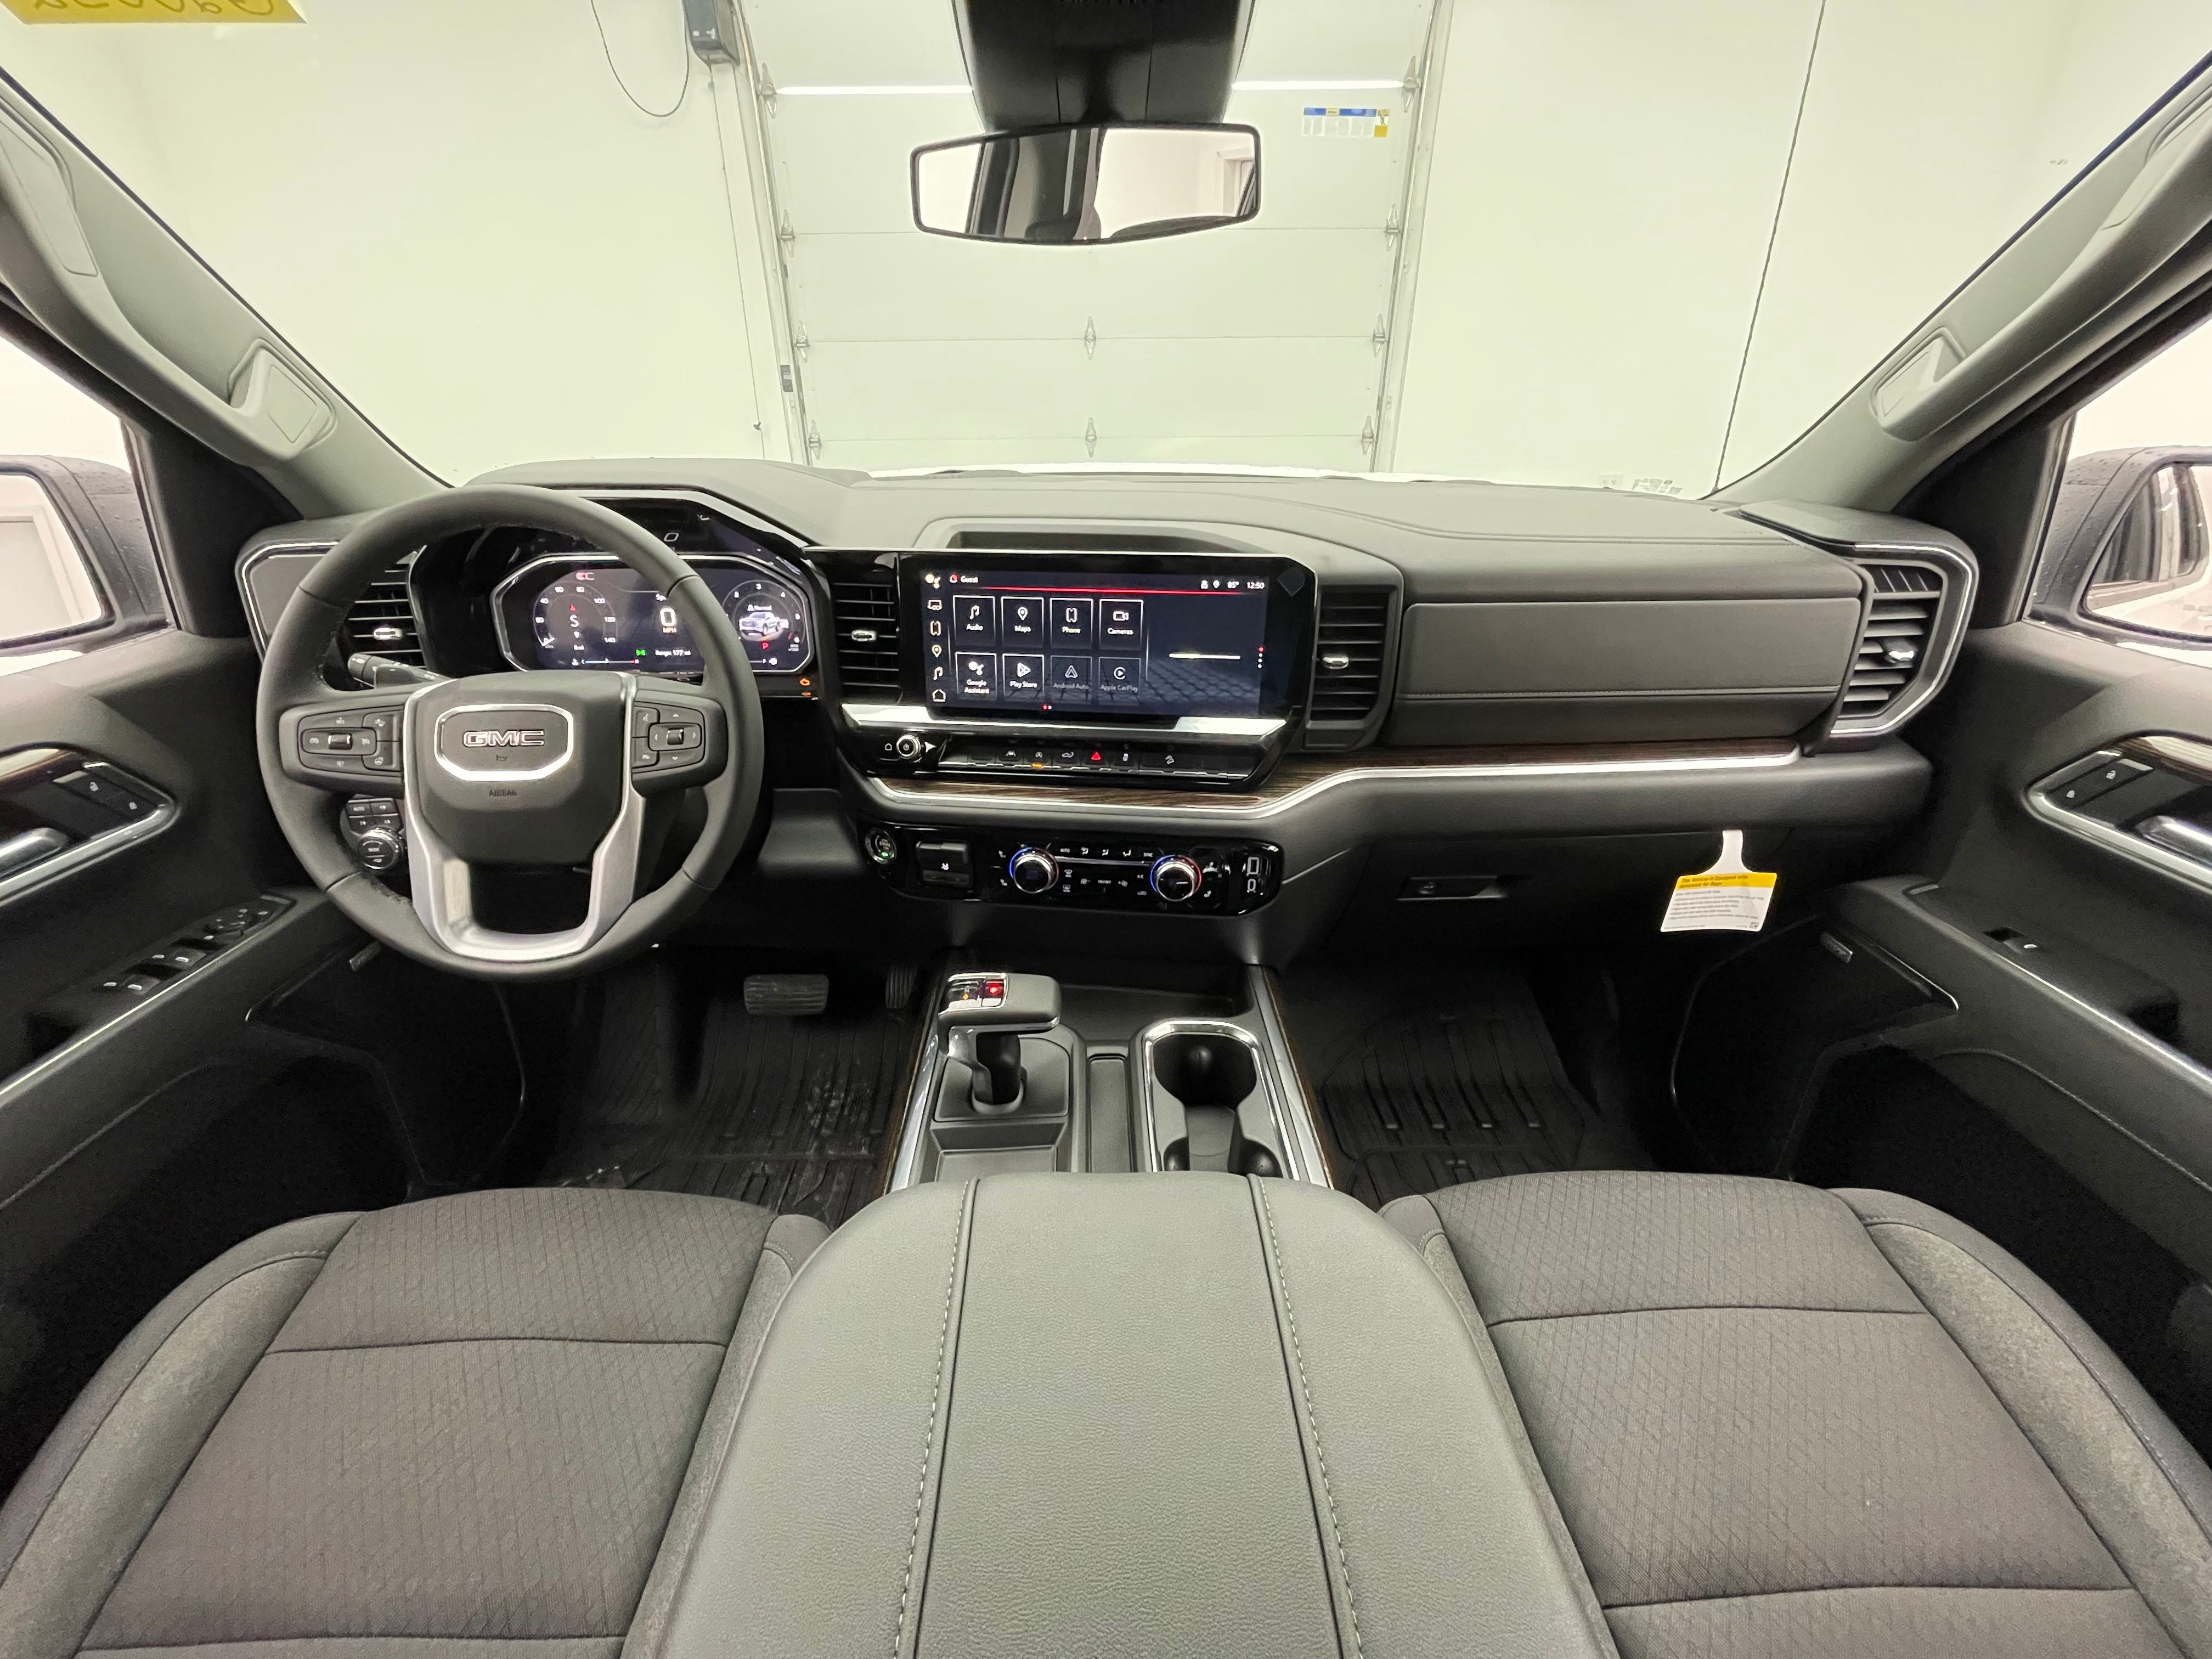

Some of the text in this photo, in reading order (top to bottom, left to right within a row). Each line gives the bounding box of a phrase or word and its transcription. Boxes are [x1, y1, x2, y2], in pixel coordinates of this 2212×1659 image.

[569, 615, 579, 628] S
[660, 607, 676, 627] 0
[1118, 685, 1139, 693] CarPlay
[462, 730, 545, 748] GMC
